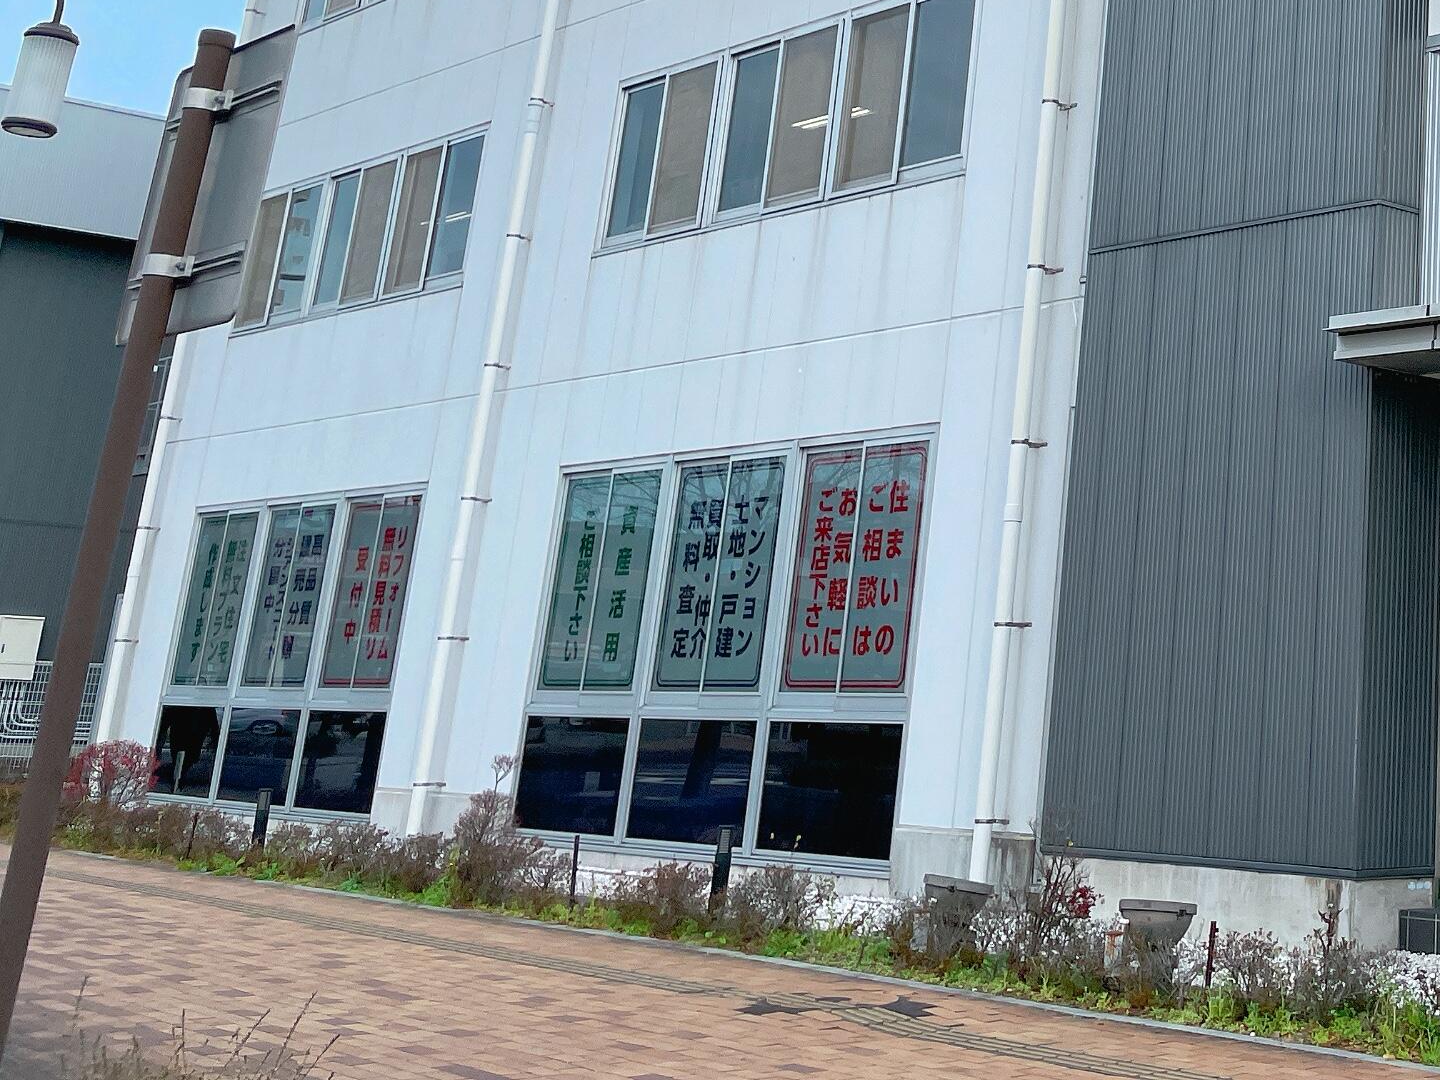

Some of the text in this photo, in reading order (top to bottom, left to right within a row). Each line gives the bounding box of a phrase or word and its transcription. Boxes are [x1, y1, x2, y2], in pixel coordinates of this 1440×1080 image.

[344, 546, 369, 646] 受付中
[377, 525, 408, 660] リフォーム
[564, 509, 597, 663] ご相談下さい
[602, 504, 639, 663] 資産活用
[670, 499, 707, 659] 無料査定
[689, 498, 725, 660] 買取・仲介
[714, 494, 750, 659] 土地・戸建
[735, 496, 770, 657] マンション
[801, 486, 839, 657] ご来店下さい
[822, 487, 858, 657] お気軽に
[852, 481, 890, 657] ご相談は
[874, 480, 911, 656] 住まいの
